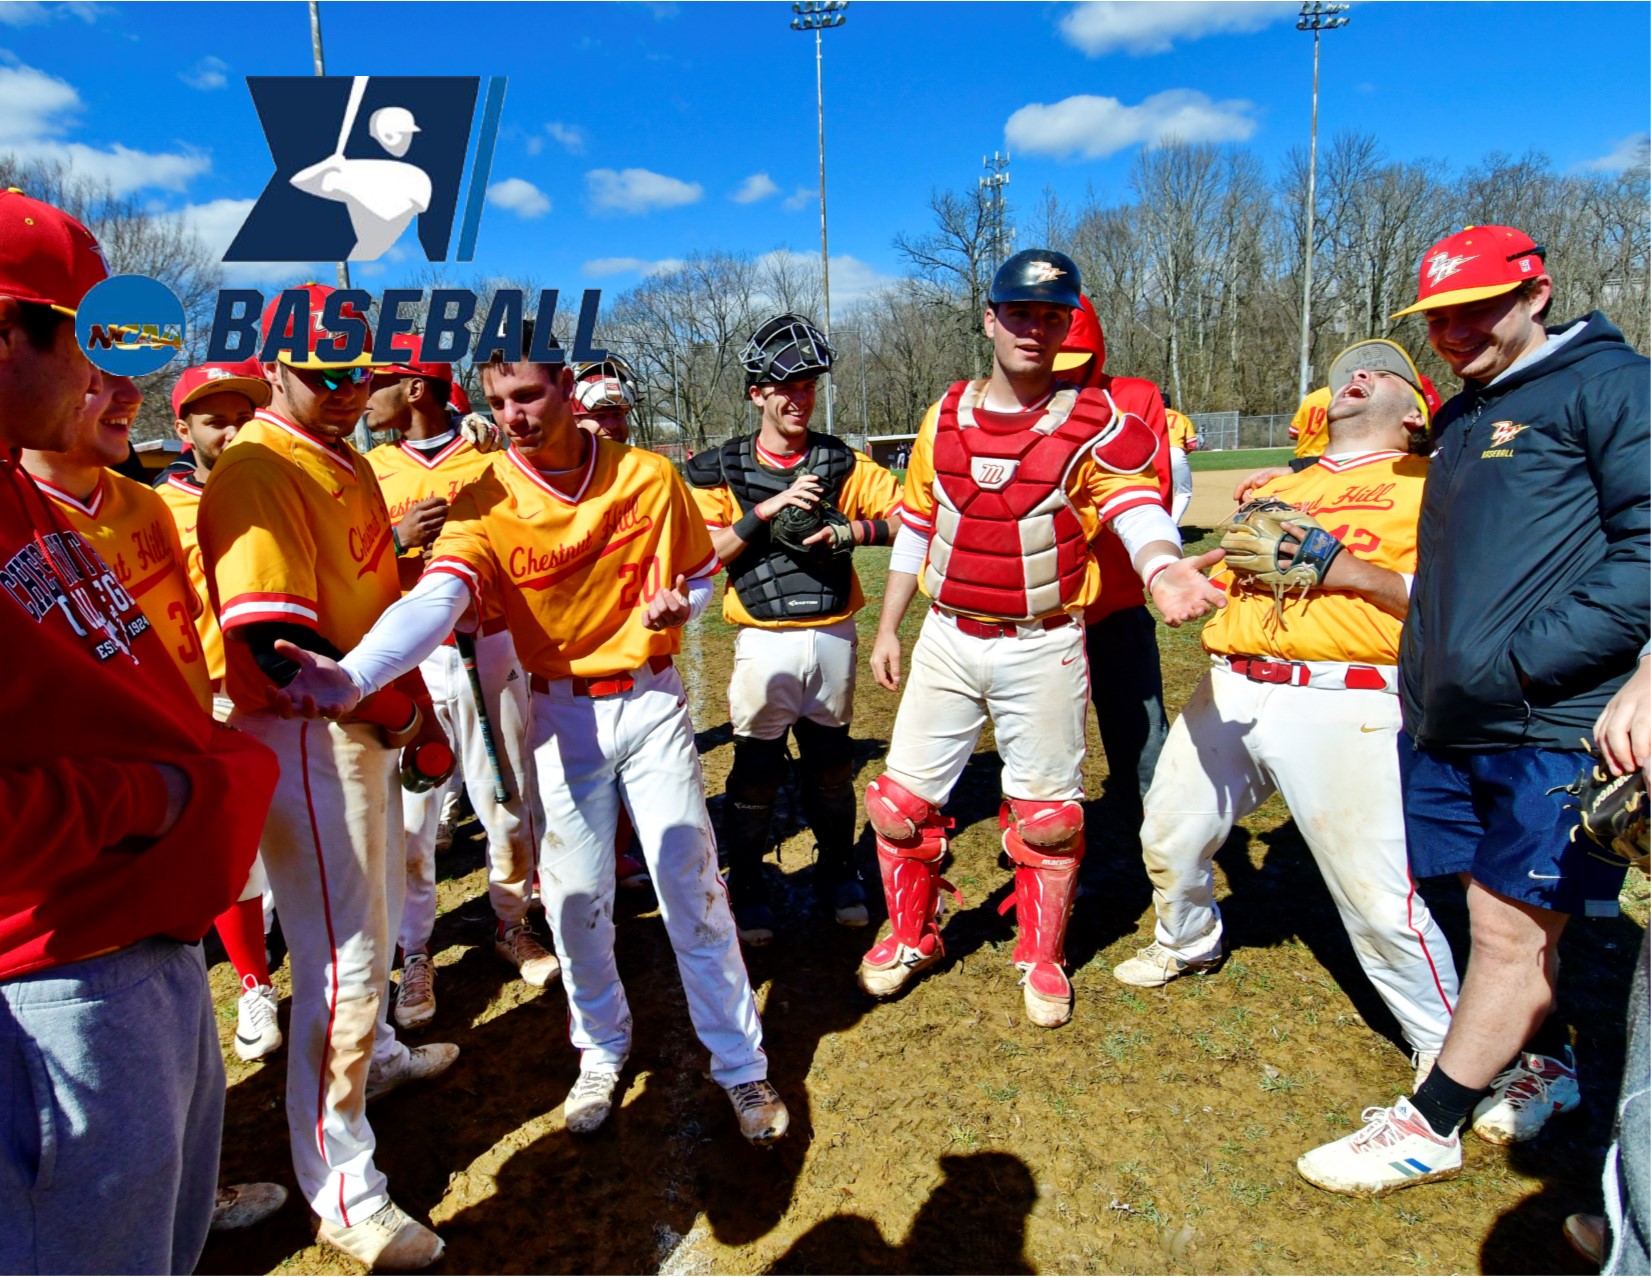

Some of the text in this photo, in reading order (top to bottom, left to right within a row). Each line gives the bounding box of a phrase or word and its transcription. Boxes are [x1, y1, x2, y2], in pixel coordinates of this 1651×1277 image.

[1332, 483, 1397, 505] Hill
[131, 519, 174, 571] Hill
[509, 493, 641, 579] Chestnut Hill
[618, 554, 661, 611] 20
[127, 615, 150, 637] 1924
